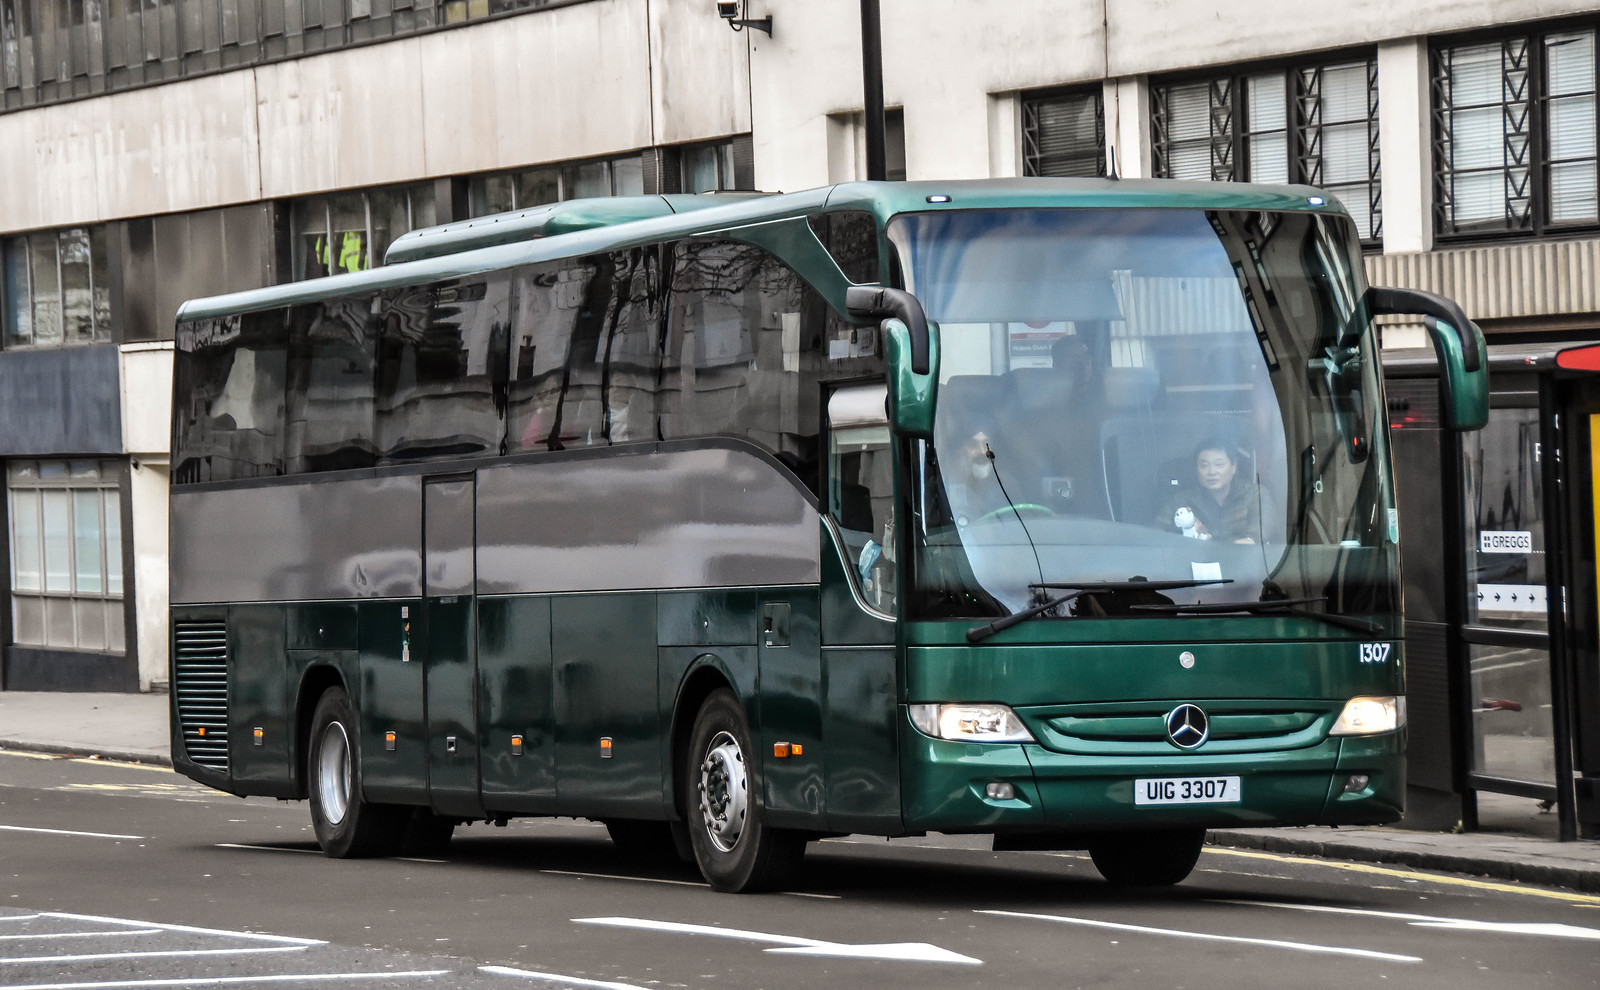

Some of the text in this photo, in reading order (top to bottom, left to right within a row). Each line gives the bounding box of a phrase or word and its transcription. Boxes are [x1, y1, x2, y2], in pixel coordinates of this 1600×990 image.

[1492, 535, 1529, 548] GREGGS
[1360, 643, 1390, 663] 1307
[1147, 779, 1227, 800] UIG 3307
